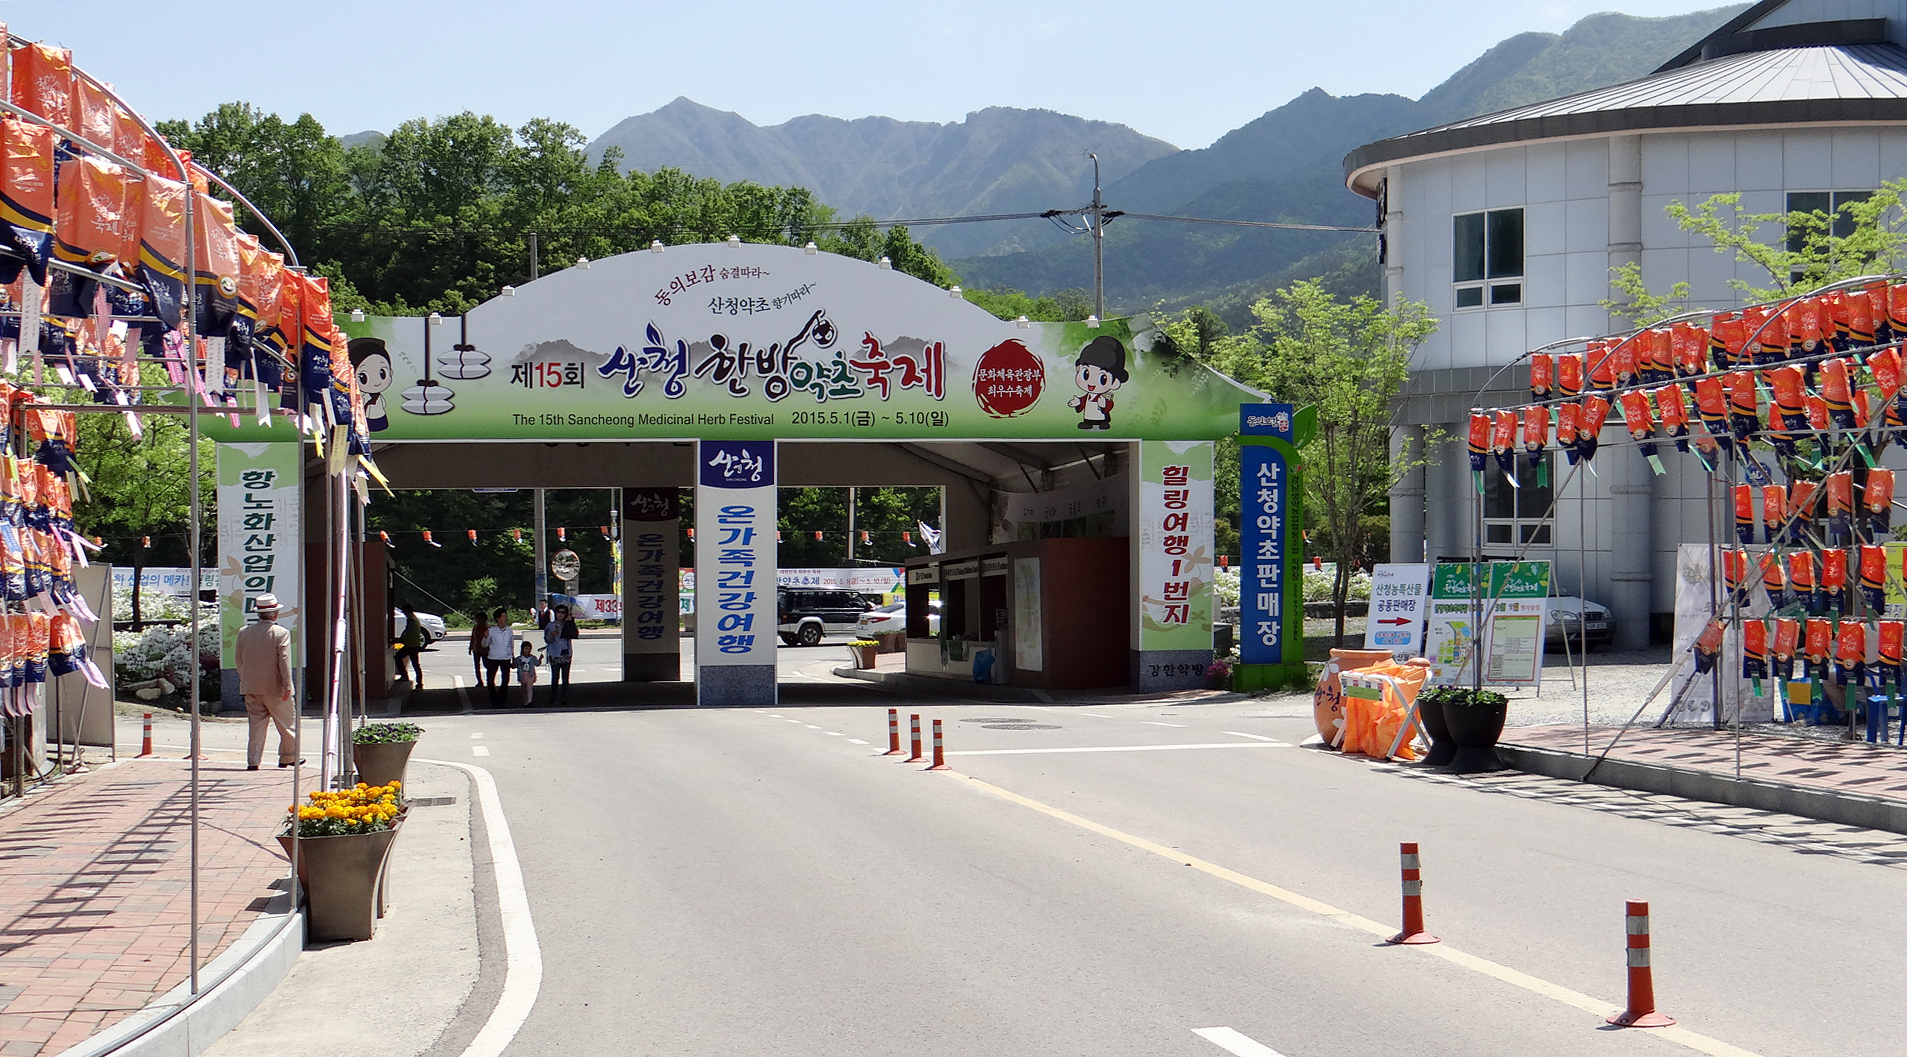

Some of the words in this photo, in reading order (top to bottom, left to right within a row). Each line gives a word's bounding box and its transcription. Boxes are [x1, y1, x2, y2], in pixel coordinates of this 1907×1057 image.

[654, 264, 716, 306] 동의보감
[707, 297, 771, 315] 산청약초
[772, 281, 817, 310] 향기따라~
[510, 362, 584, 388] 제15회
[597, 320, 690, 398] 산청
[978, 367, 1042, 382] 문화체육관광부
[987, 384, 1033, 398] 최우수축제
[512, 414, 536, 425] The
[539, 414, 564, 425] 15th
[567, 414, 635, 429] Sancheong
[638, 414, 694, 425] Medicinal
[698, 414, 726, 425] Herb
[730, 413, 774, 425] Festival
[792, 411, 876, 427] 2015.5.1(금)
[895, 411, 949, 427] 5.10(일)
[242, 470, 276, 627] 항노화산업의
[1162, 465, 1190, 625] 힐링여행1번지
[1256, 462, 1281, 646] 산청약초판매장
[636, 533, 666, 640] 온가족건강여행
[717, 505, 757, 654] 온가족건강여행
[1375, 583, 1422, 596] 산청농특산물
[1377, 599, 1416, 612] 공동판매장
[1148, 663, 1204, 677] 강한약방
